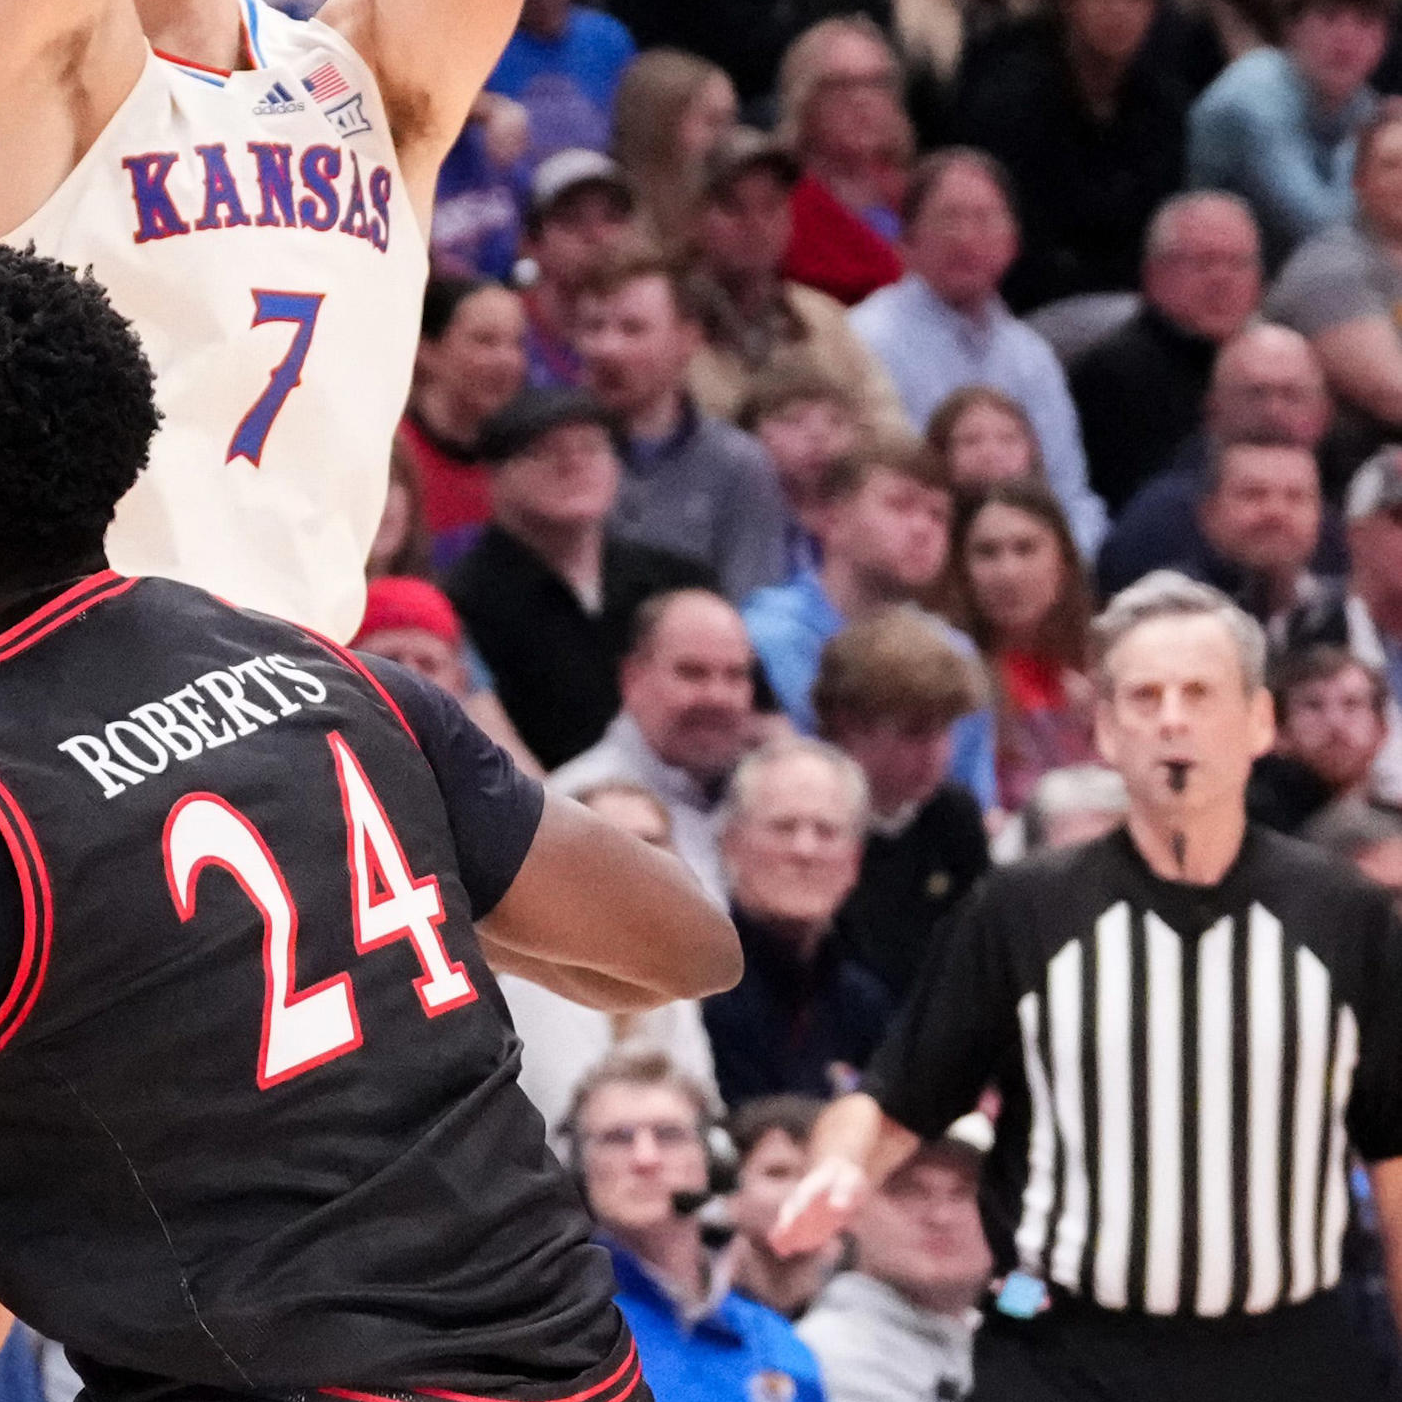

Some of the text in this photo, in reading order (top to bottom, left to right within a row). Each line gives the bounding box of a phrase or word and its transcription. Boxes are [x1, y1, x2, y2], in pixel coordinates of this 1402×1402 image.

[251, 101, 306, 116] adidas
[121, 140, 393, 255] KANSAS
[224, 287, 327, 469] 7
[57, 652, 328, 800] ROBERTS
[161, 729, 480, 1091] 24
